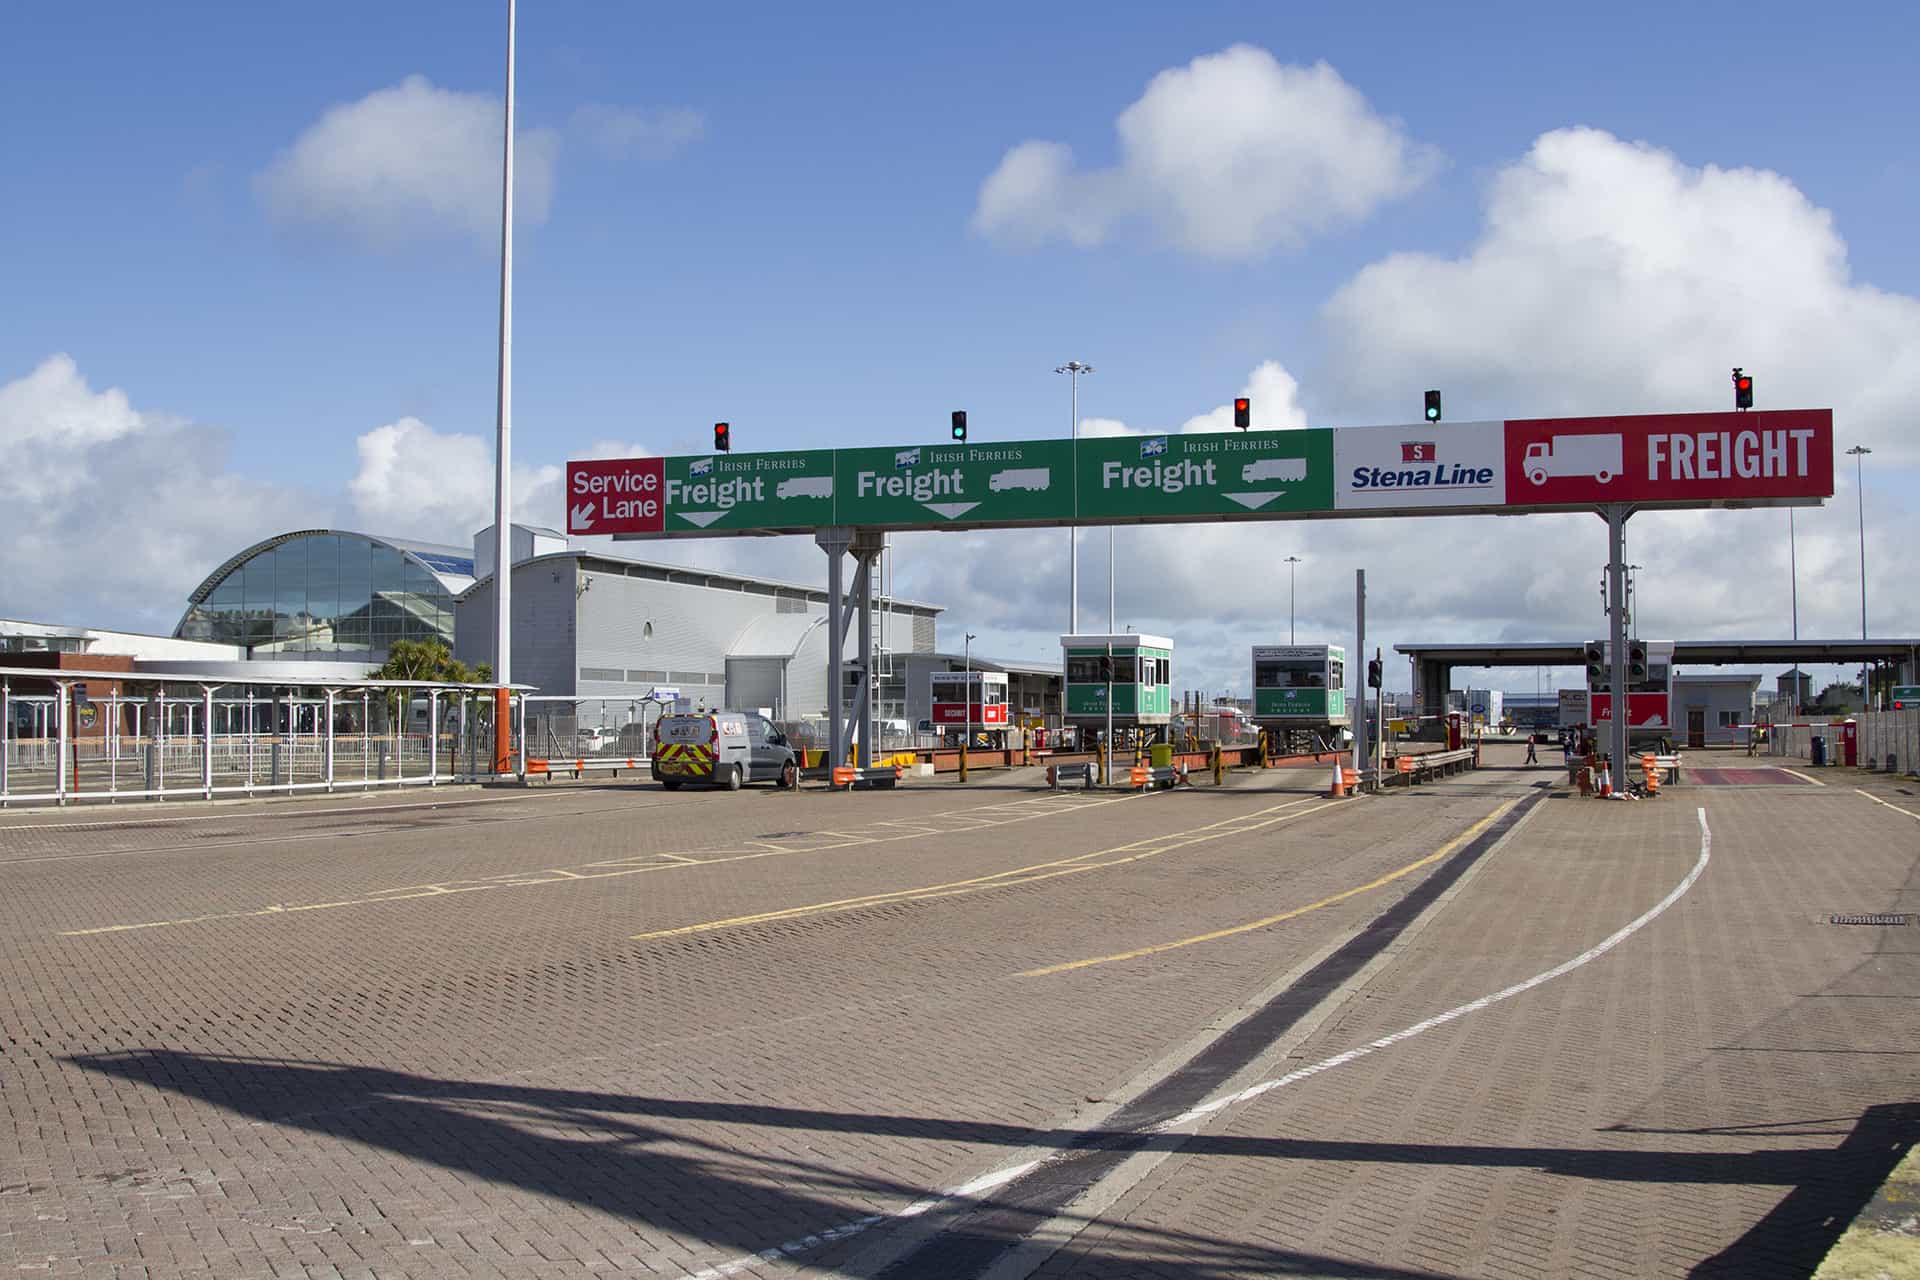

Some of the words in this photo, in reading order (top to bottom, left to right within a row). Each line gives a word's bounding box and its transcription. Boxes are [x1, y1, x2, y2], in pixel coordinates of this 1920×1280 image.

[930, 450, 964, 463] IRISH
[970, 449, 1023, 461] FERRIES
[1183, 440, 1219, 453] IRISH
[1224, 438, 1279, 451] FERRIES
[1413, 445, 1424, 460] S
[1647, 429, 1816, 481] FREIGHT
[719, 460, 751, 472] IRISH
[756, 458, 806, 470] FERRIES
[1102, 458, 1217, 493] Freight
[1351, 466, 1431, 489] Stena
[1434, 463, 1494, 485] Line
[573, 469, 657, 495] Service
[665, 476, 765, 509] Freight
[857, 468, 964, 501] Freight
[602, 495, 657, 519] Lane
